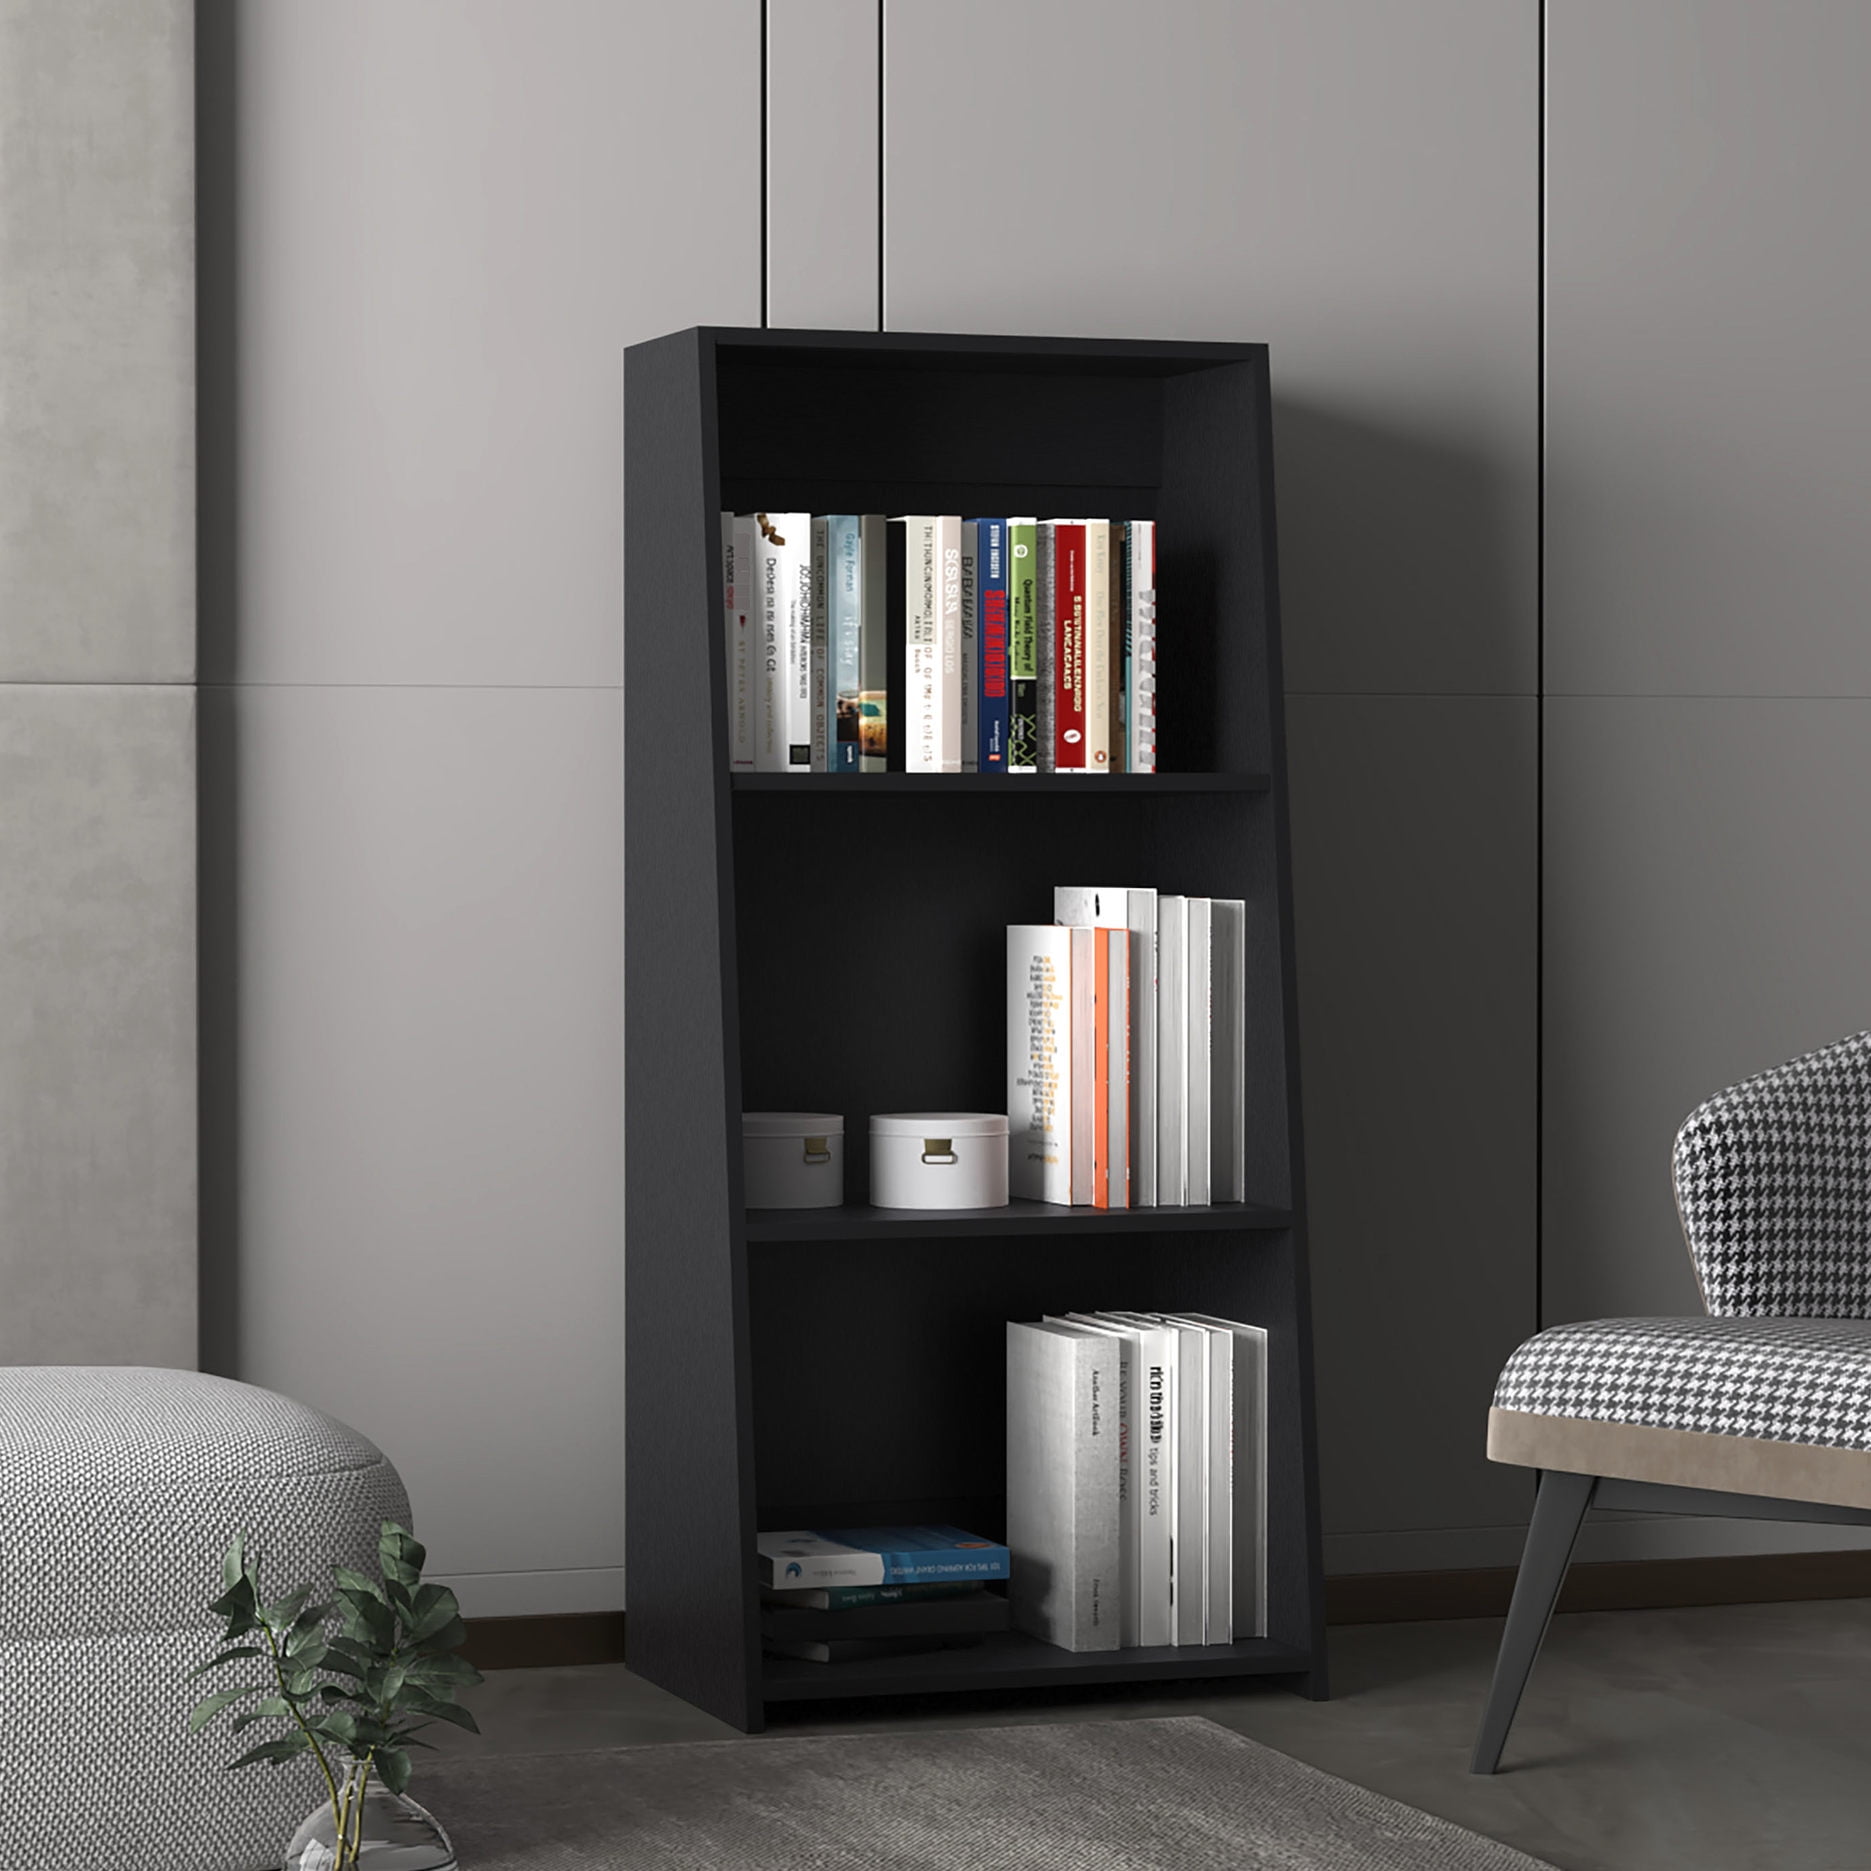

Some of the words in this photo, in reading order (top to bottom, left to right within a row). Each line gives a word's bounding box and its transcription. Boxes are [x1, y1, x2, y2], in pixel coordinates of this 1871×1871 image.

[816, 530, 825, 547] THE
[844, 533, 855, 558] Gayle
[816, 556, 825, 608] UNCOMMON
[845, 560, 855, 592] Forman
[1021, 579, 1034, 614] Quantum
[816, 616, 825, 640] LIFE
[1024, 616, 1034, 635] Field
[816, 648, 825, 660] OF
[1021, 636, 1034, 661] Theory
[1024, 663, 1034, 672] of
[816, 668, 825, 707] COMMON
[816, 714, 825, 761] OBJECTS
[1148, 1447, 1159, 1466] tips
[1150, 1468, 1158, 1487] and
[1149, 1488, 1160, 1516] tricks
